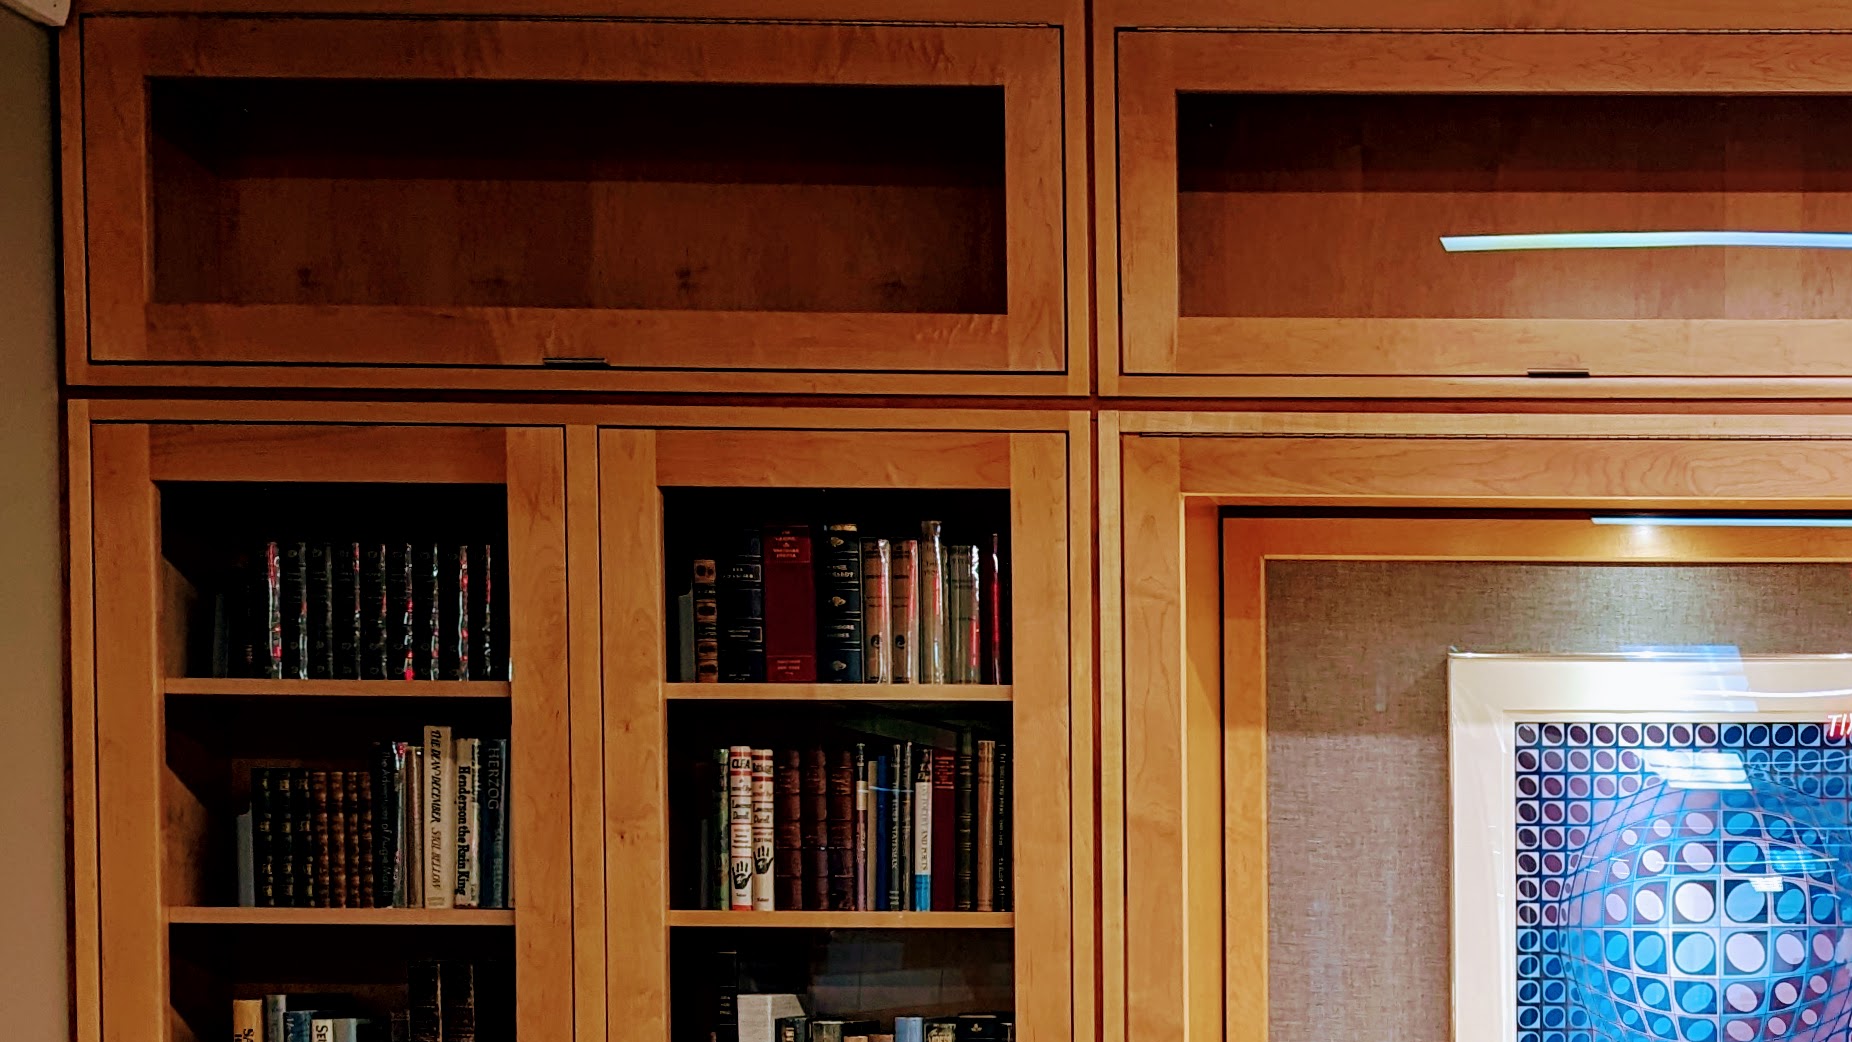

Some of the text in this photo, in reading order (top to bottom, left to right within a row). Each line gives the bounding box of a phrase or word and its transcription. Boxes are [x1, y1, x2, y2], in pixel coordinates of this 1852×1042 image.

[430, 730, 442, 747] THE
[487, 747, 500, 810] HERZOG
[731, 758, 750, 769] CLEA
[430, 776, 442, 824] DECEMBER
[455, 766, 471, 896] Henderson the Rain King
